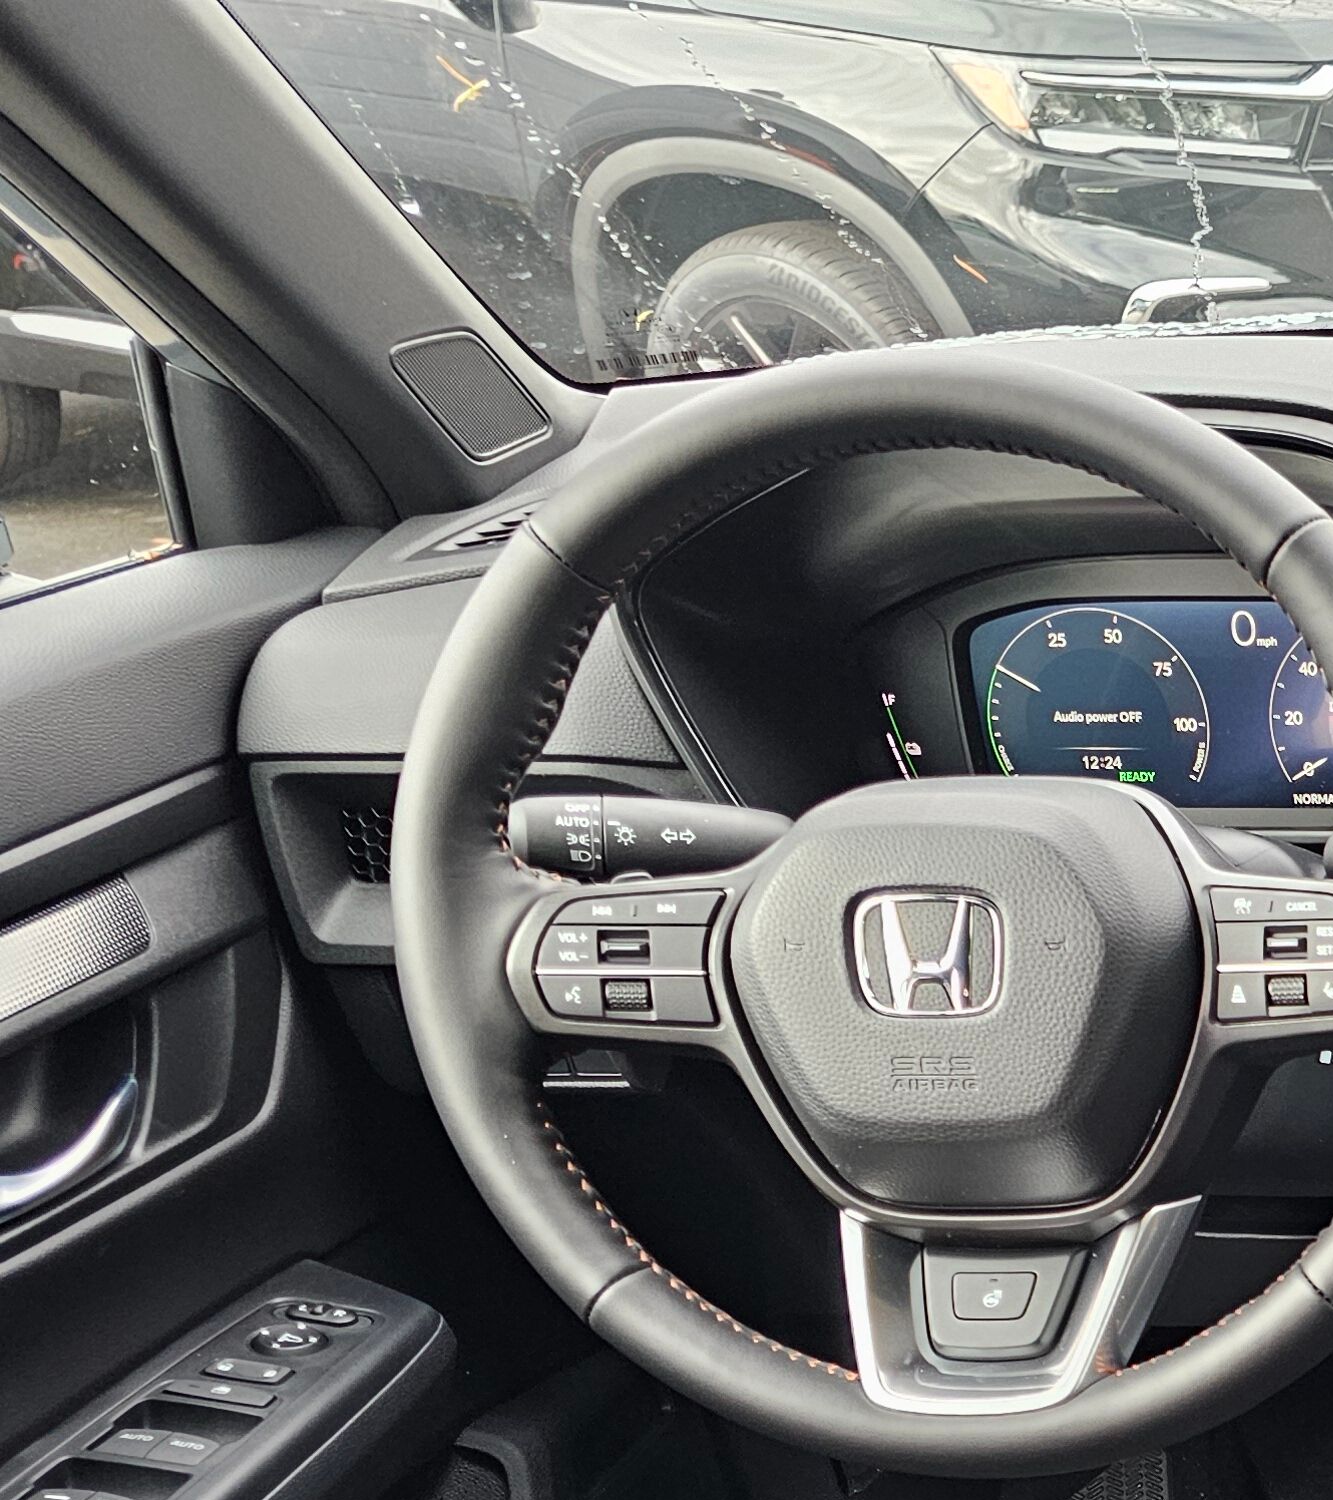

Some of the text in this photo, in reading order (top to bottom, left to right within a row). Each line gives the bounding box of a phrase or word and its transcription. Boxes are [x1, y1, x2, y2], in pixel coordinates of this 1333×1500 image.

[1230, 610, 1278, 648] 0 mph
[1048, 633, 1067, 648] 25
[1104, 629, 1123, 645] 50
[1153, 662, 1173, 678] 75
[1298, 661, 1318, 677] 40
[887, 693, 896, 706] F
[1053, 711, 1143, 725] Audio power OFF
[1173, 717, 1198, 733] 100
[1284, 710, 1304, 726] 20
[1082, 755, 1122, 770] 12:24
[1119, 771, 1155, 783] READY
[555, 815, 591, 828] AUTO
[1285, 901, 1318, 912] CANCEL
[891, 1056, 976, 1074] SRS
[892, 1078, 979, 1092] AIRBAG
[120, 1433, 154, 1442] AUTO
[170, 1439, 205, 1451] AUTO
